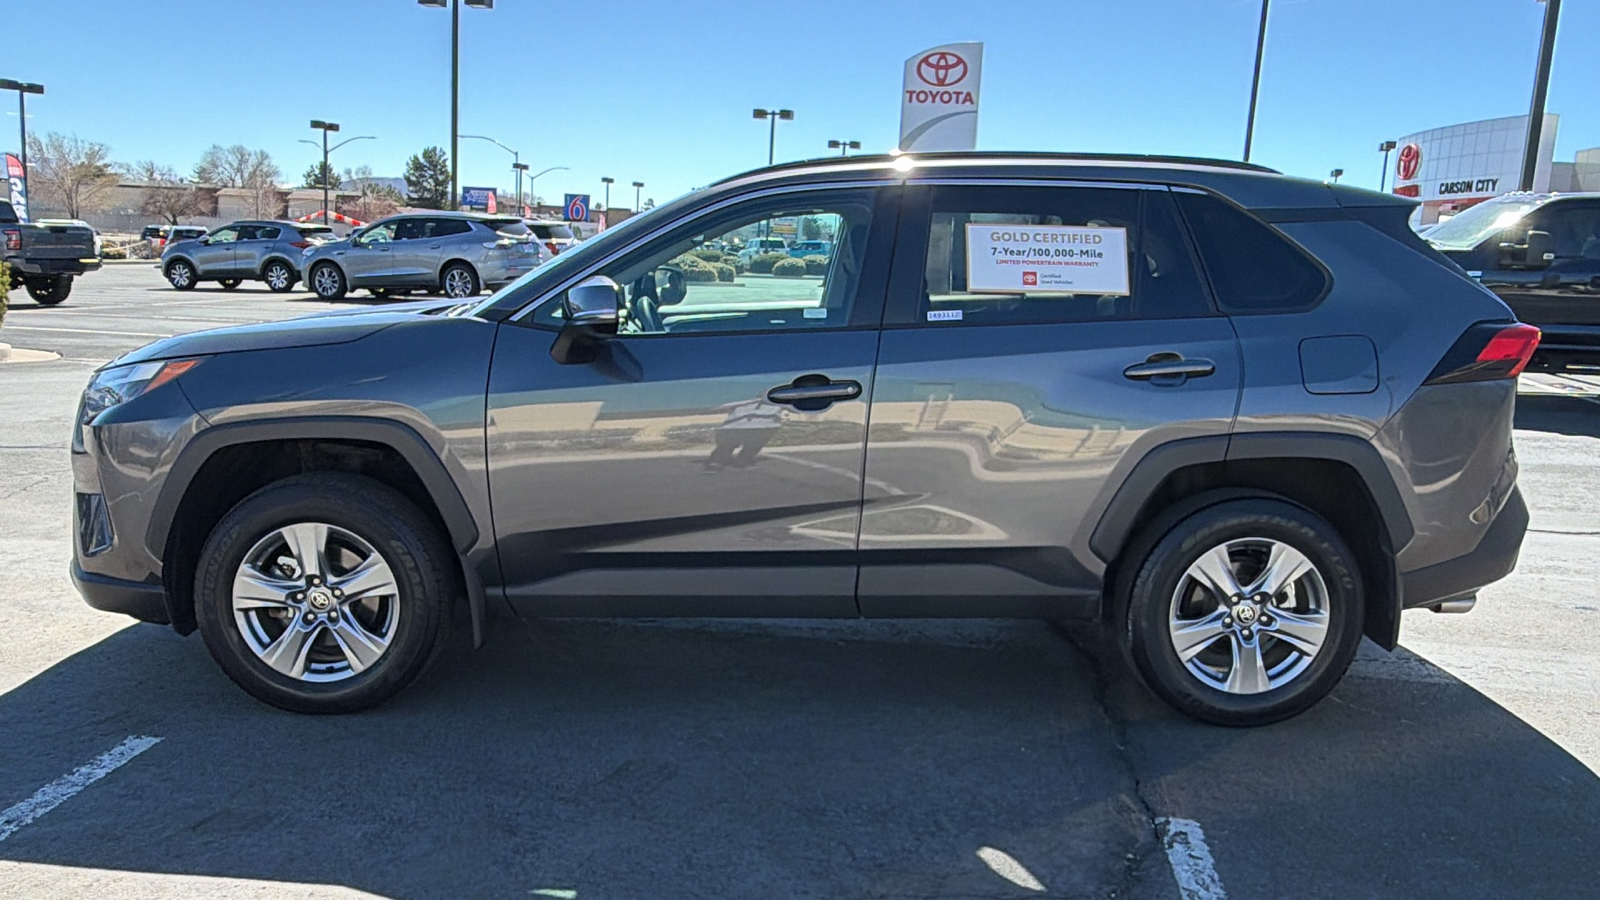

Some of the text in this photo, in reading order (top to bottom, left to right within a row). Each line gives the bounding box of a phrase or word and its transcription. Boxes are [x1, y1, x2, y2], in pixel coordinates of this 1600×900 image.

[905, 90, 975, 105] TOYOTA
[1439, 178, 1499, 195] CARSON CITY
[568, 196, 586, 221] 6
[990, 231, 1102, 245] GOLD CERTIFIED
[990, 247, 1103, 259] 7-Year/100,000-Mile
